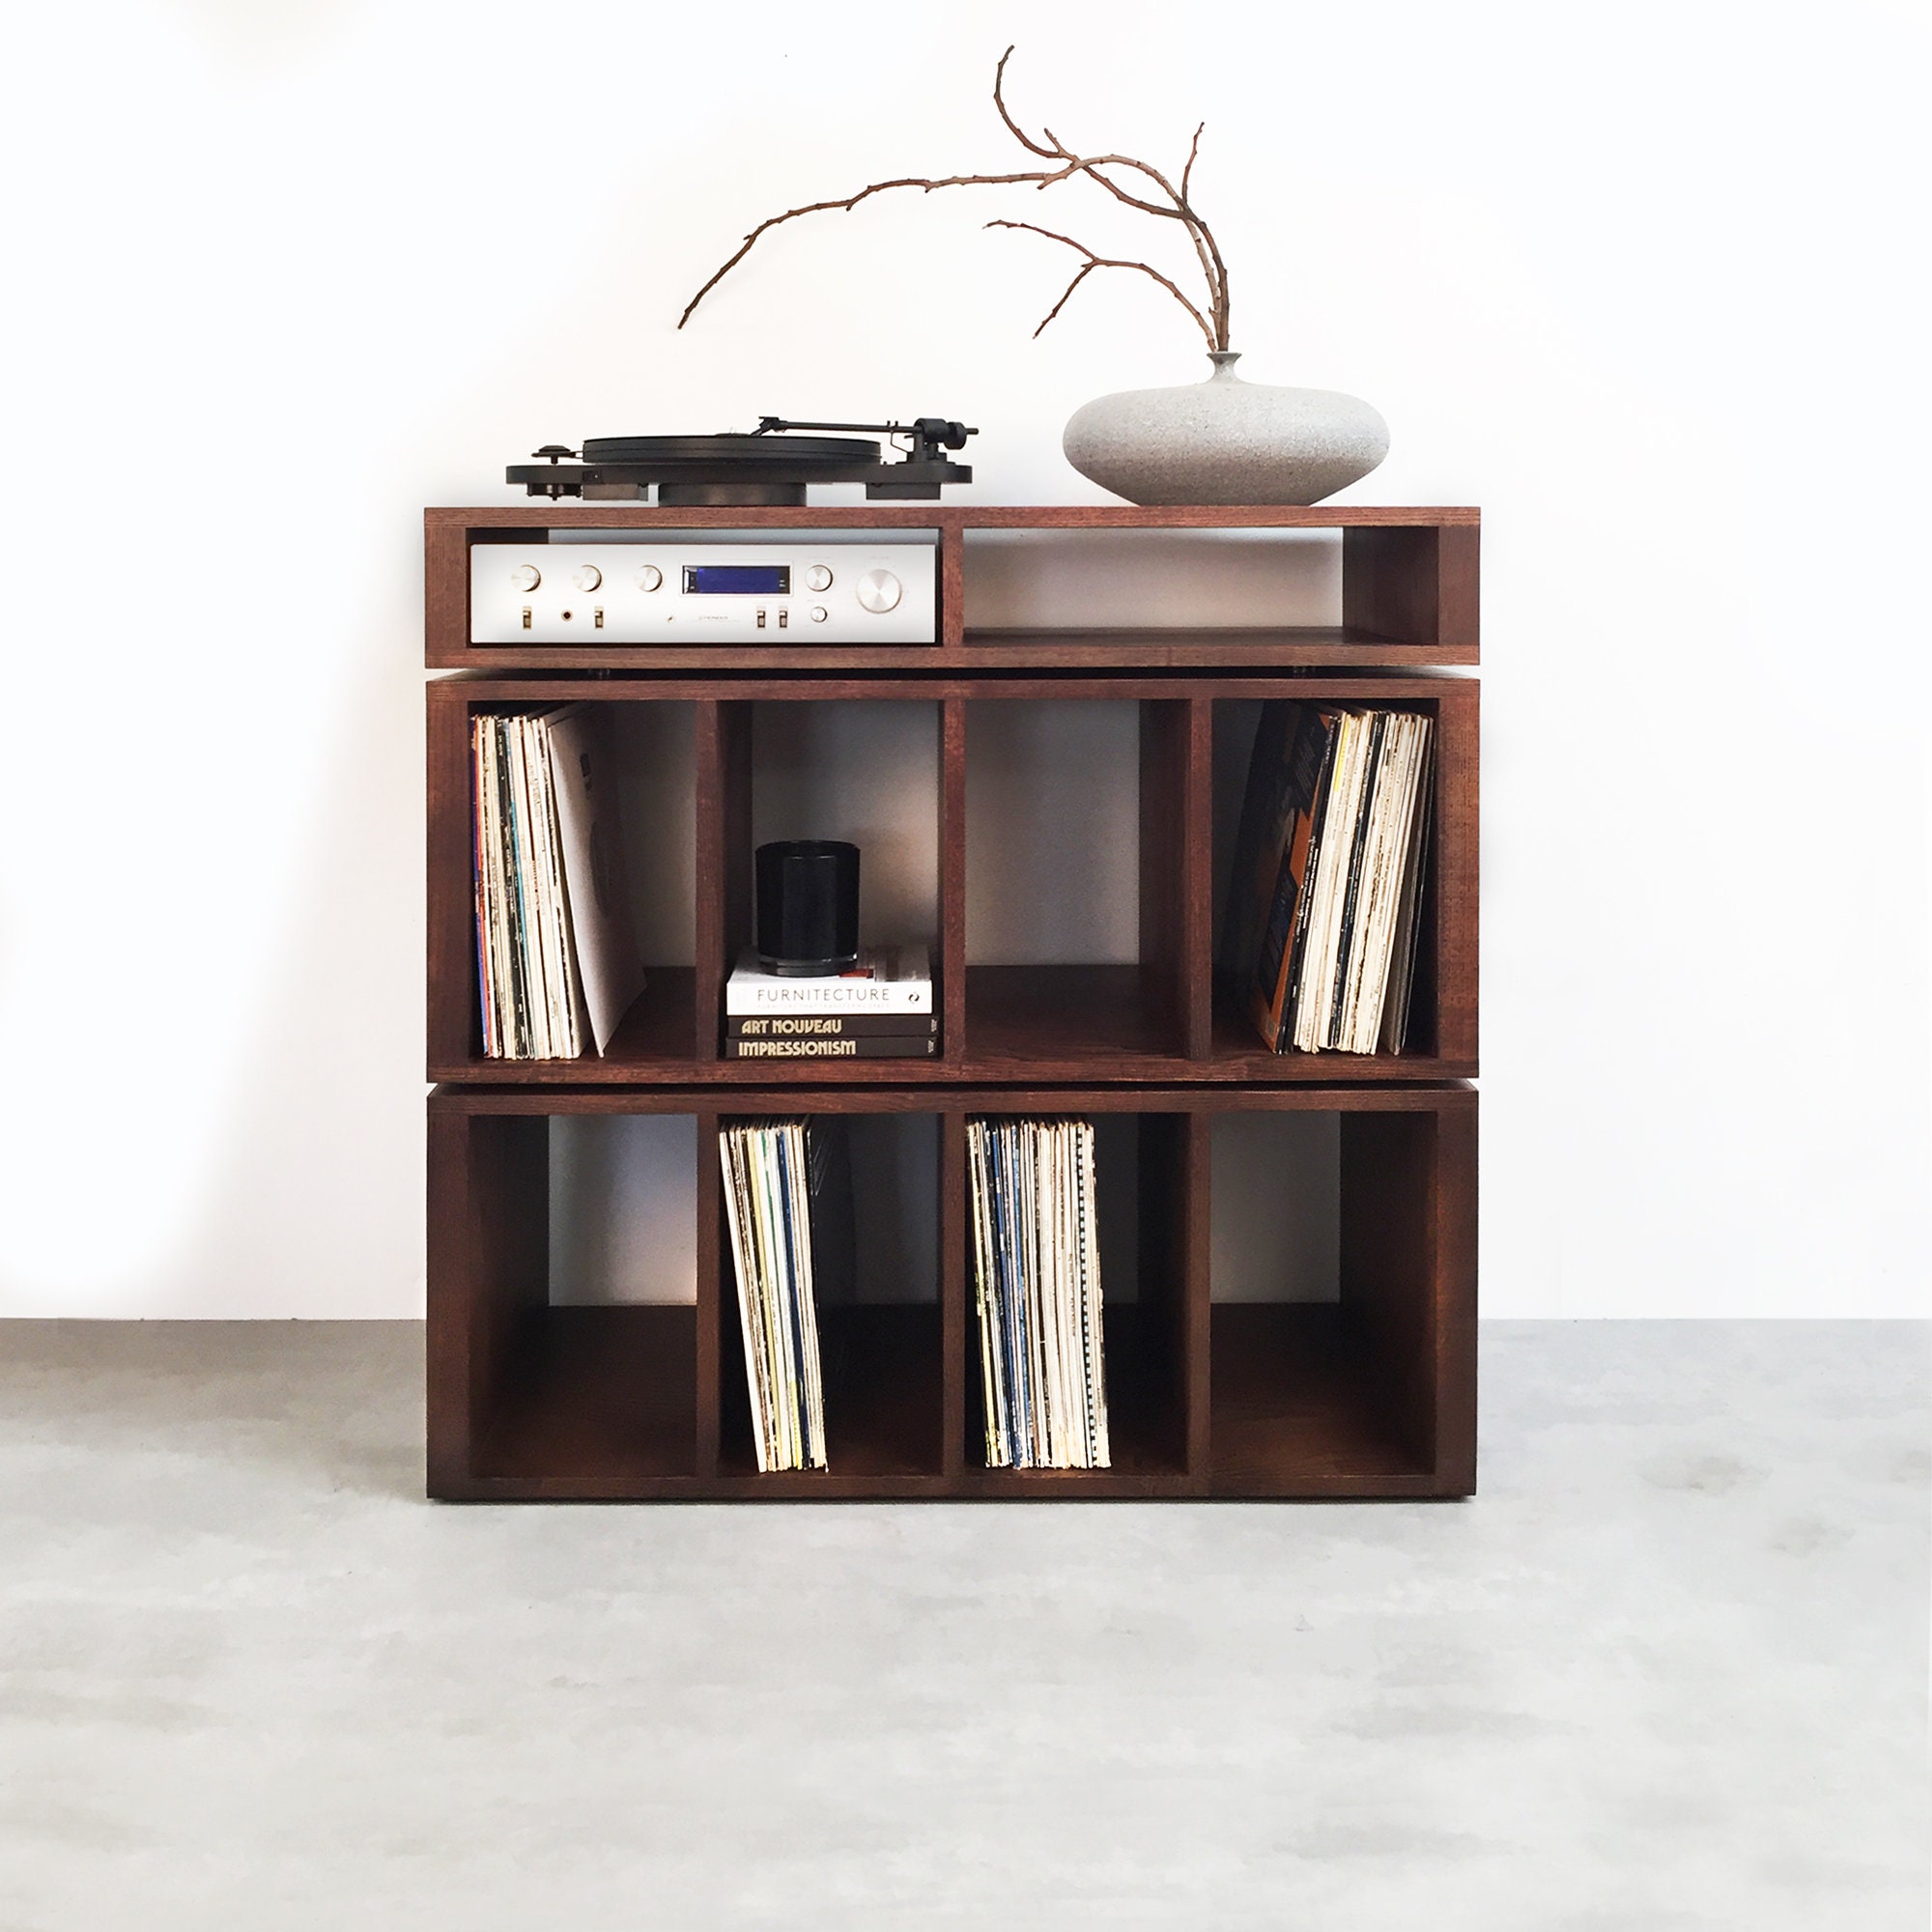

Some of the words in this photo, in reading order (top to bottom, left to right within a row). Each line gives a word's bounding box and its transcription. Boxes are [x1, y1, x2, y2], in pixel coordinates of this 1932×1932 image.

[757, 988, 890, 1002] FURNITECTURE
[741, 1019, 770, 1035] ART
[772, 1019, 842, 1034] NOUVEAU
[738, 1040, 857, 1056] IMPRESSIONISM
